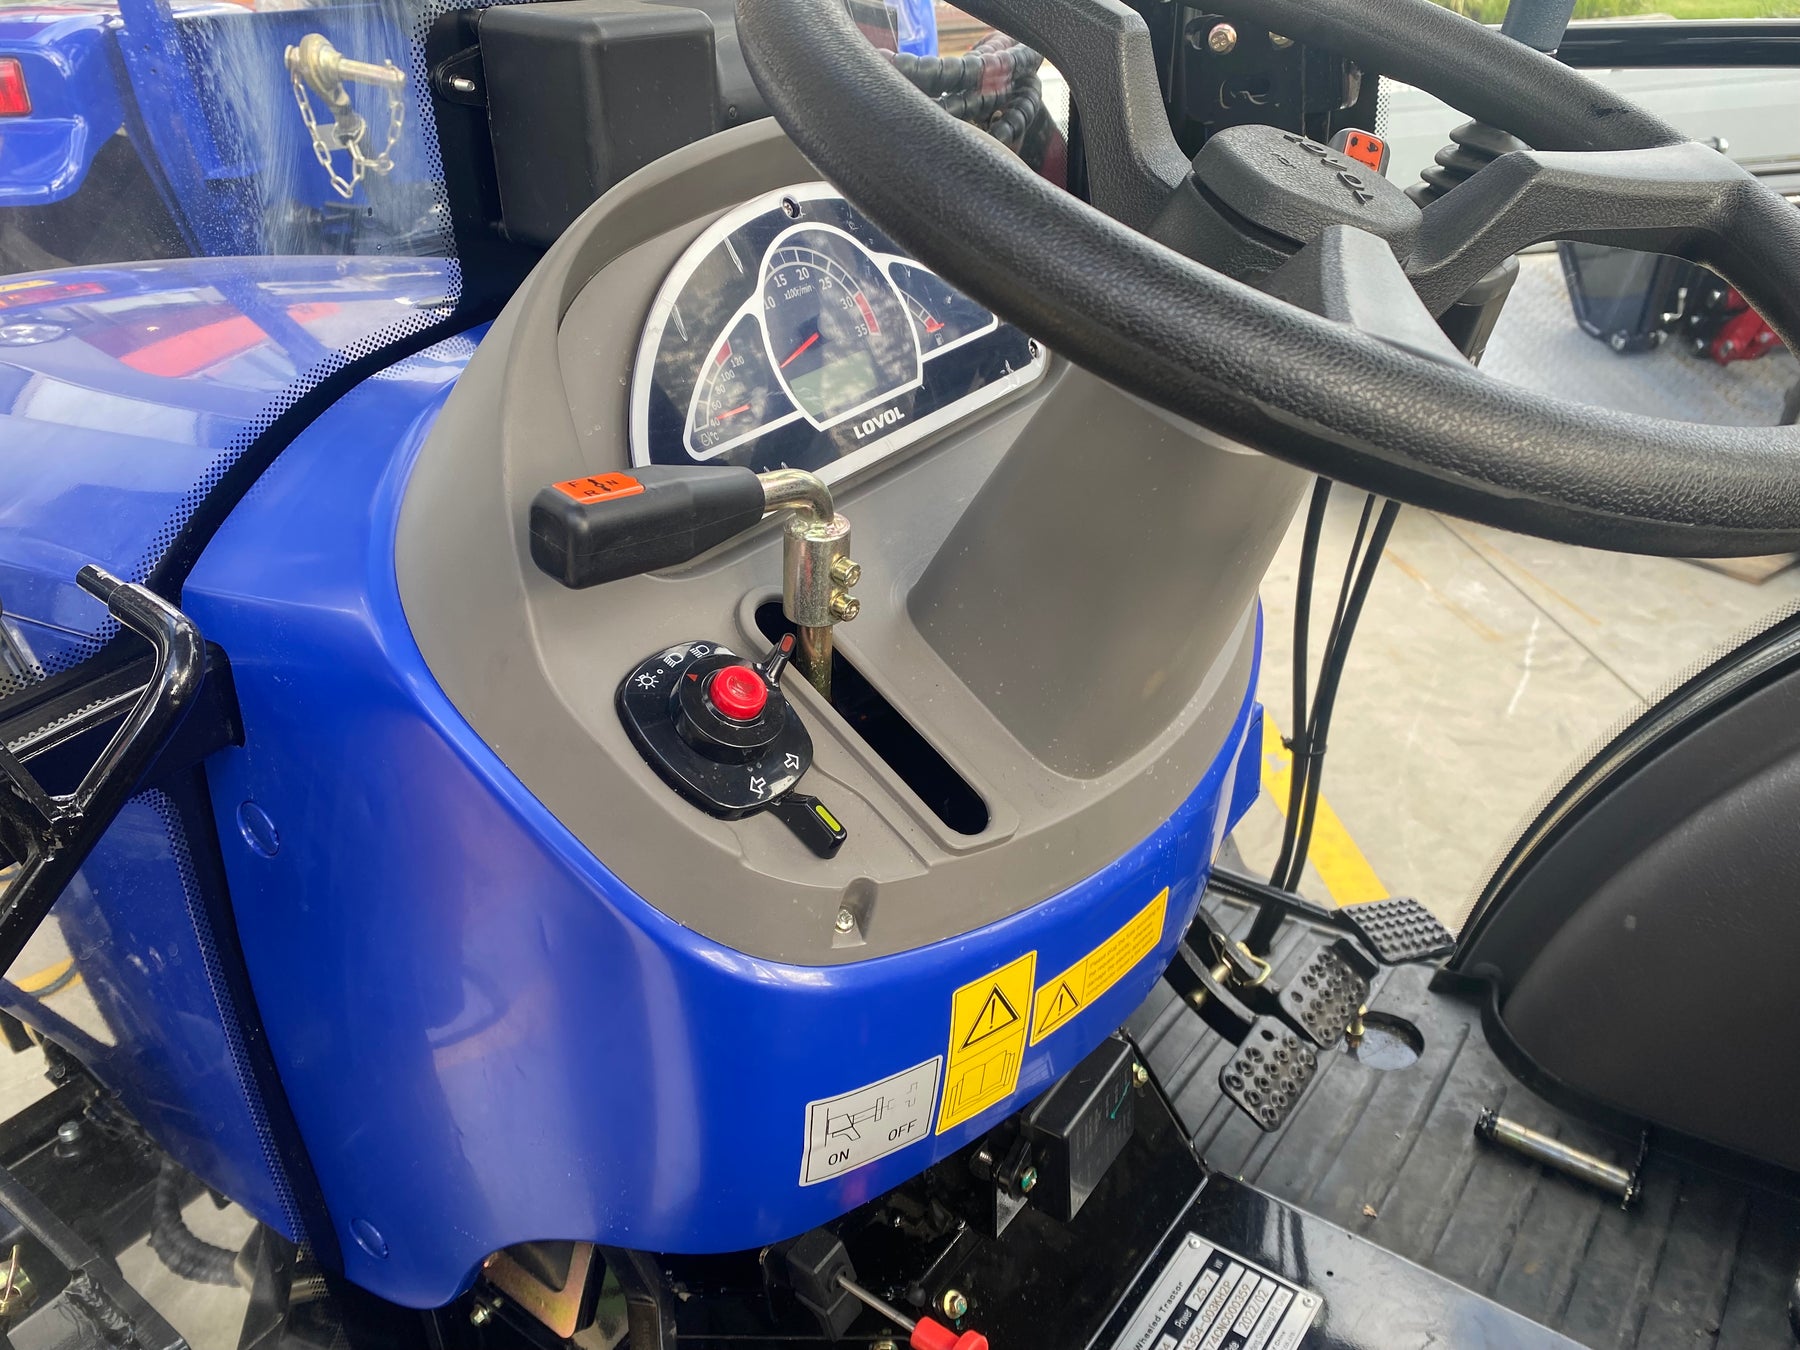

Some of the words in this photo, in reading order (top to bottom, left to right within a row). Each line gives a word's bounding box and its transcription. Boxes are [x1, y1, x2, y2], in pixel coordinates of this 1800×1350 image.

[774, 273, 788, 288] 15
[796, 266, 810, 281] 20
[819, 276, 833, 290] 25
[764, 295, 776, 310] 10
[840, 295, 854, 310] 30
[855, 322, 868, 337] 35
[730, 355, 745, 369] 120
[720, 369, 736, 382] 100
[714, 383, 726, 396] 80
[711, 400, 722, 411] 60
[710, 416, 721, 429] 40
[853, 406, 905, 440] LOVOL
[887, 1119, 919, 1142] OFF
[828, 1147, 850, 1166] ON
[1158, 1280, 1184, 1313] Tractor
[1173, 1308, 1193, 1331] Power
[1192, 1273, 1215, 1303] 25.7
[1239, 1289, 1269, 1331] 2022/02
